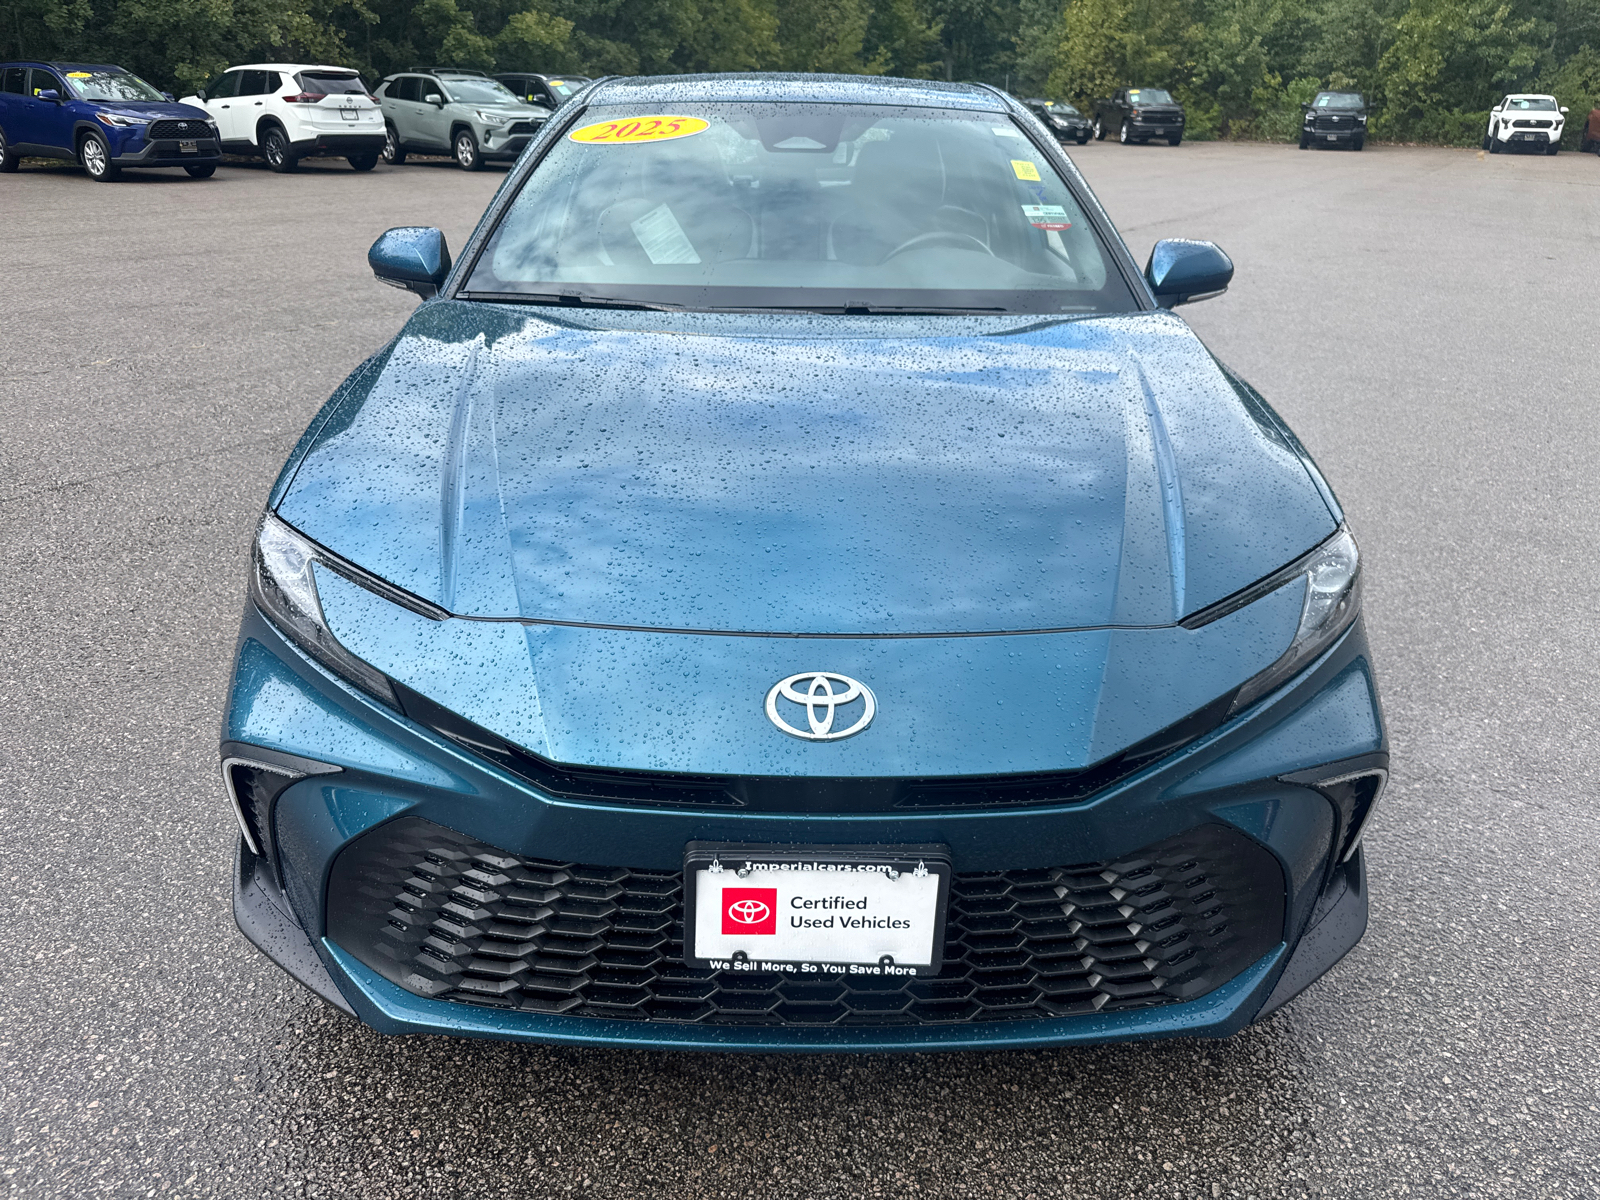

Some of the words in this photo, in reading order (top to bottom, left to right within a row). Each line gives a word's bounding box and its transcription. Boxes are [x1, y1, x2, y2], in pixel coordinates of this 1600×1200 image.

[590, 119, 687, 140] 2025
[745, 861, 893, 873] Imperialcars.com
[790, 896, 867, 910] Certified
[790, 915, 835, 929] Used
[839, 915, 911, 930] Vehicles
[709, 960, 730, 970] We
[733, 961, 757, 971] Sell
[761, 962, 797, 974] More,
[801, 963, 818, 973] So
[821, 964, 846, 973] You
[849, 965, 880, 974] Save
[884, 966, 917, 976] More
